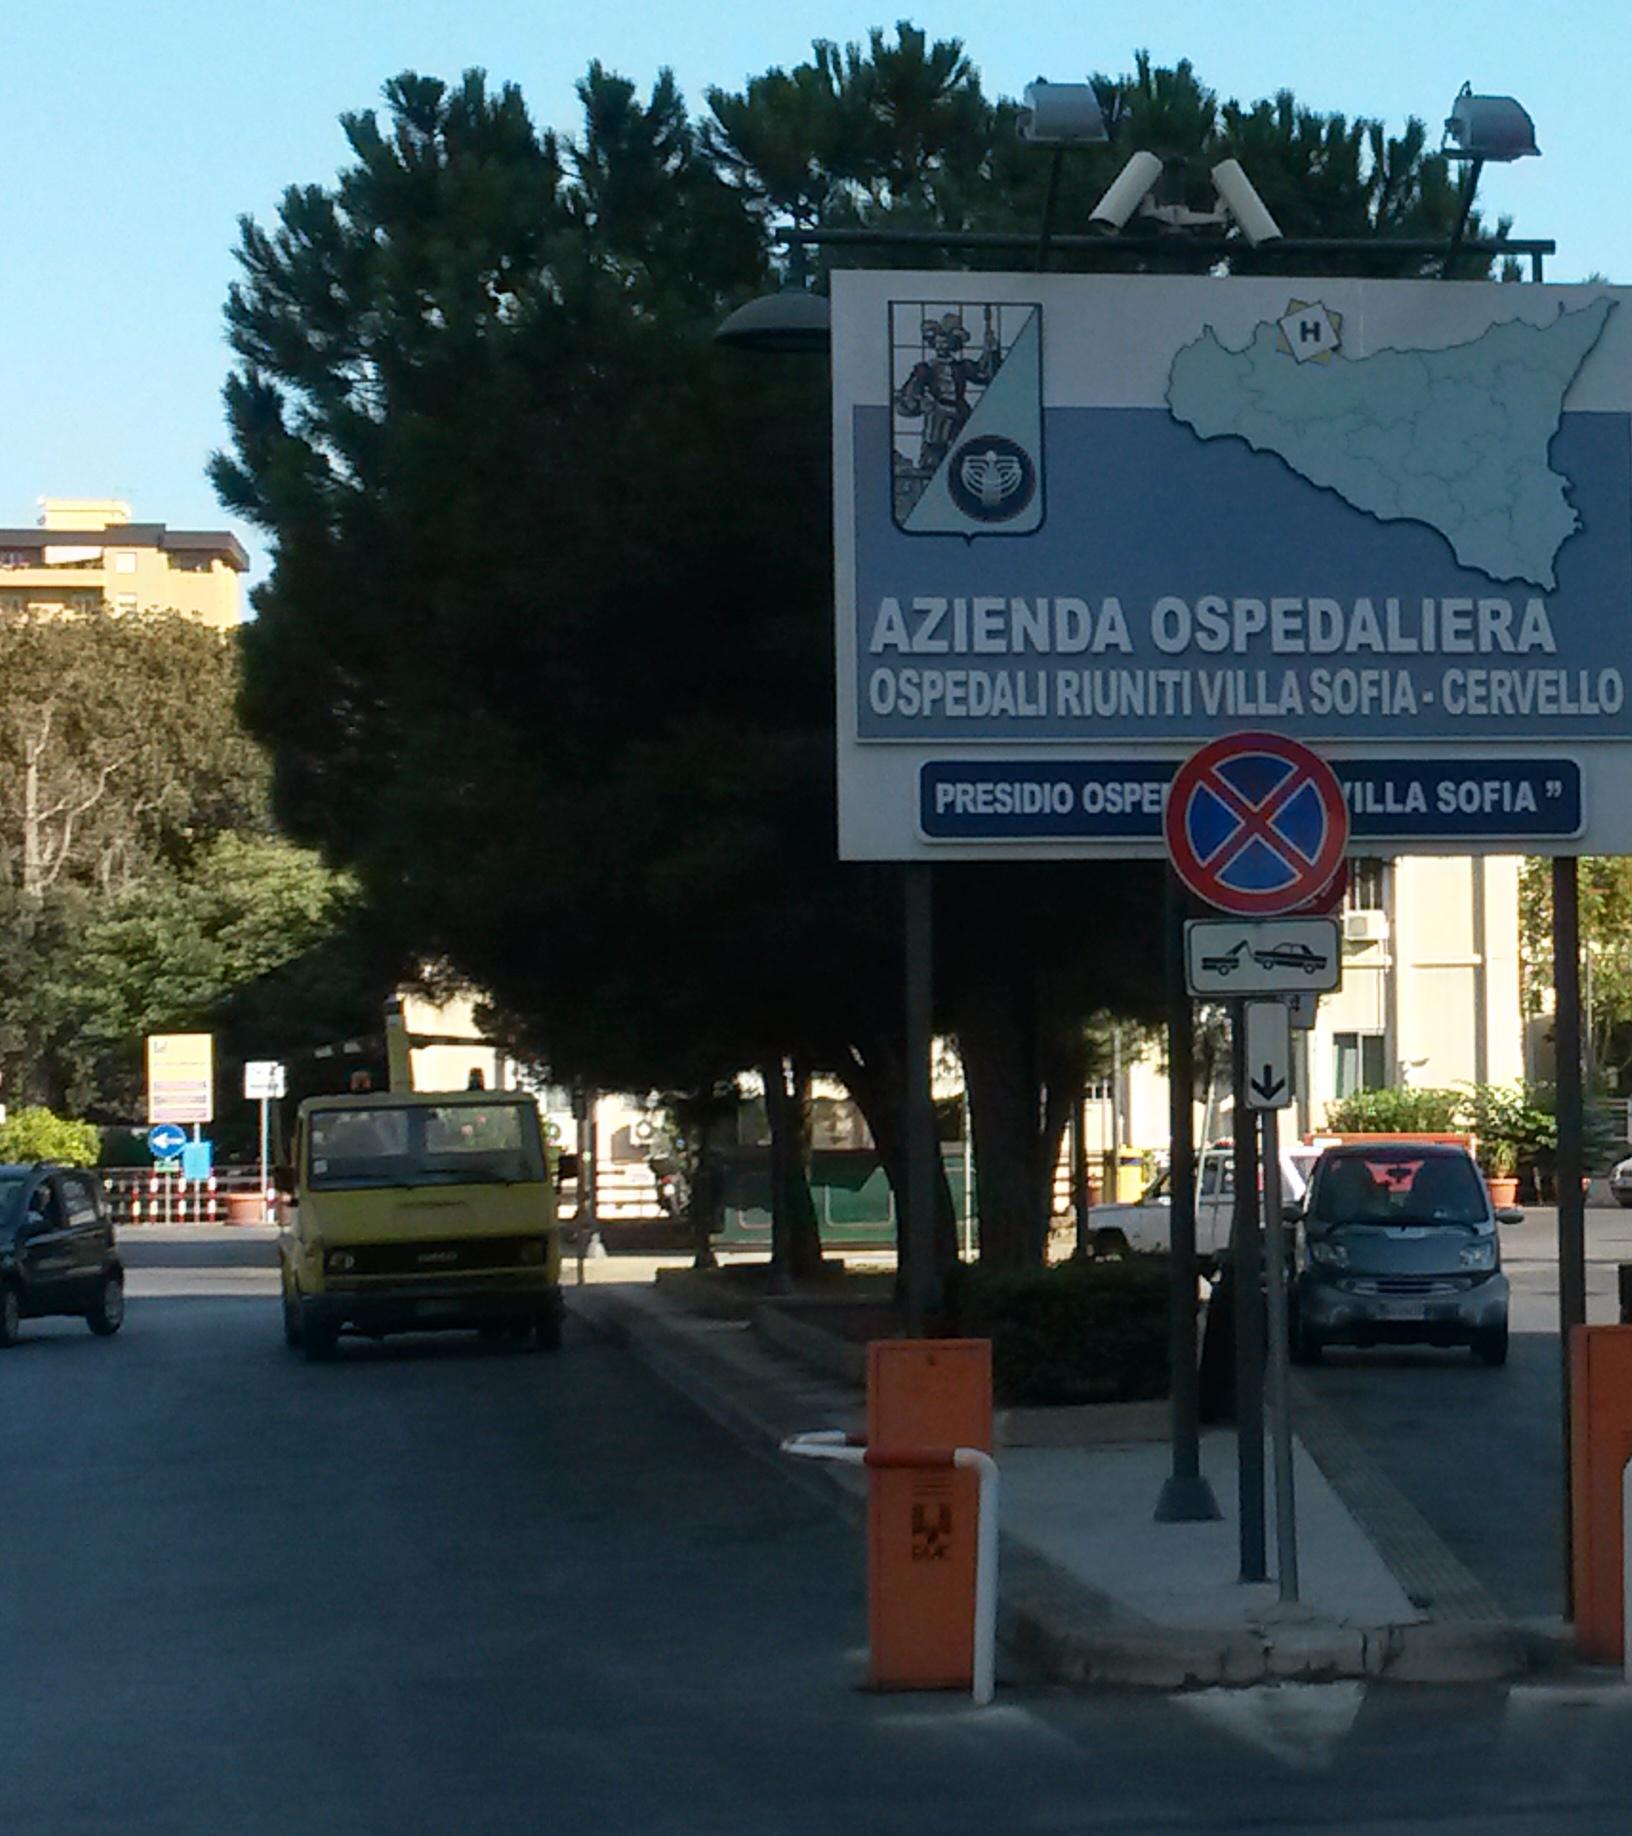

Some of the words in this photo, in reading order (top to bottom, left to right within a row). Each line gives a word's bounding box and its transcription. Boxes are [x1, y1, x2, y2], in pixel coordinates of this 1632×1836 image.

[1300, 320, 1321, 343] H
[869, 597, 1135, 655] AZIENDA
[1150, 595, 1557, 654] OSPEDALIERA
[868, 667, 1048, 717] OSPEDALI
[1056, 669, 1192, 717] RIUNITI
[1198, 669, 1304, 716] VILLA
[1309, 668, 1417, 716] SOFIA
[1441, 666, 1625, 716] CERVELLO
[935, 782, 1074, 814] PRESIDIO
[1082, 782, 1171, 814] OSPE
[1436, 780, 1538, 814] SOFIA
